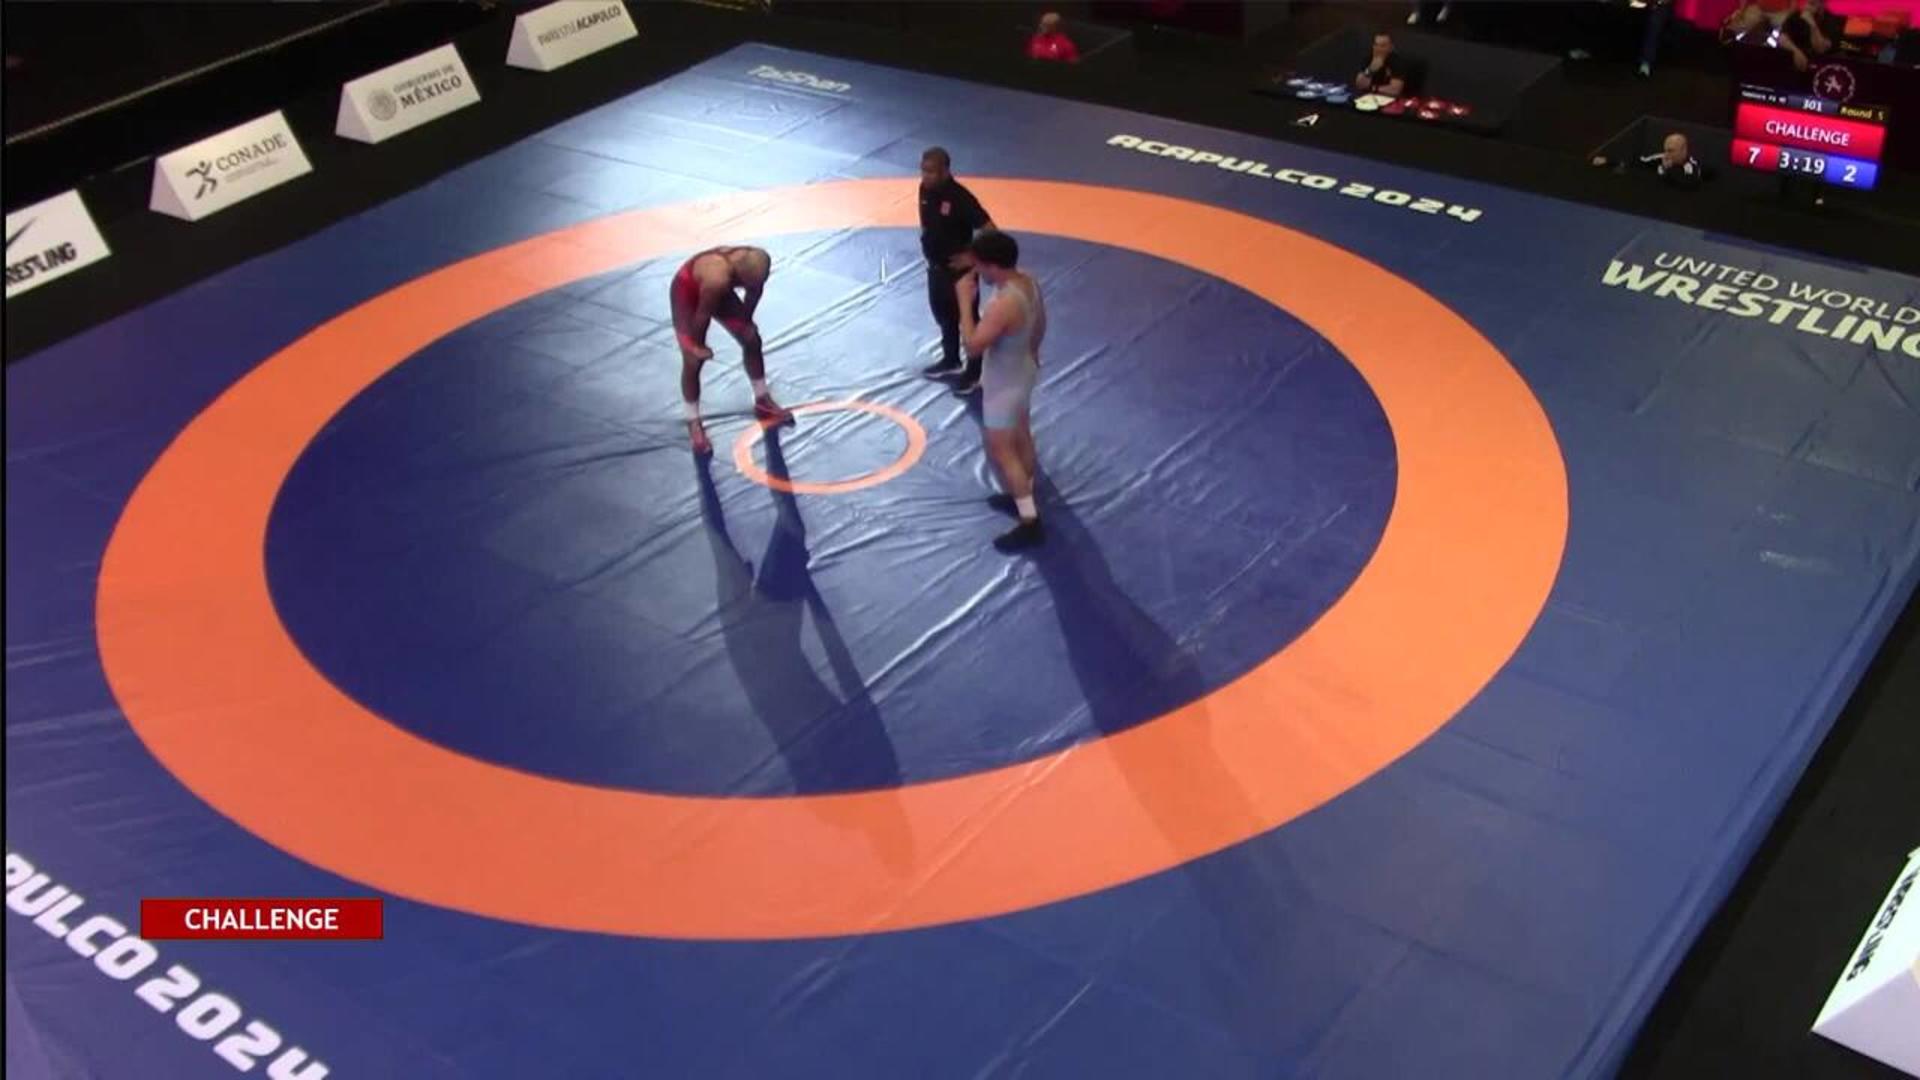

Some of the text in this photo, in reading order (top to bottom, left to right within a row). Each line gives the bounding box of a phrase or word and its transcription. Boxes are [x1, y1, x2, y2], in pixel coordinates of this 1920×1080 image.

[400, 74, 462, 109] MÉXICO
[747, 65, 851, 92] TaiShan
[1841, 106, 1873, 119] Round
[1765, 120, 1850, 146] CHALLENGE
[215, 133, 288, 172] CONADE
[1748, 147, 1761, 164] 7
[1779, 152, 1825, 174] 3:19
[1106, 134, 1483, 223] ACAPULCO 2024
[1843, 165, 1857, 182] 2
[1654, 252, 1920, 324] UNITED WORLD
